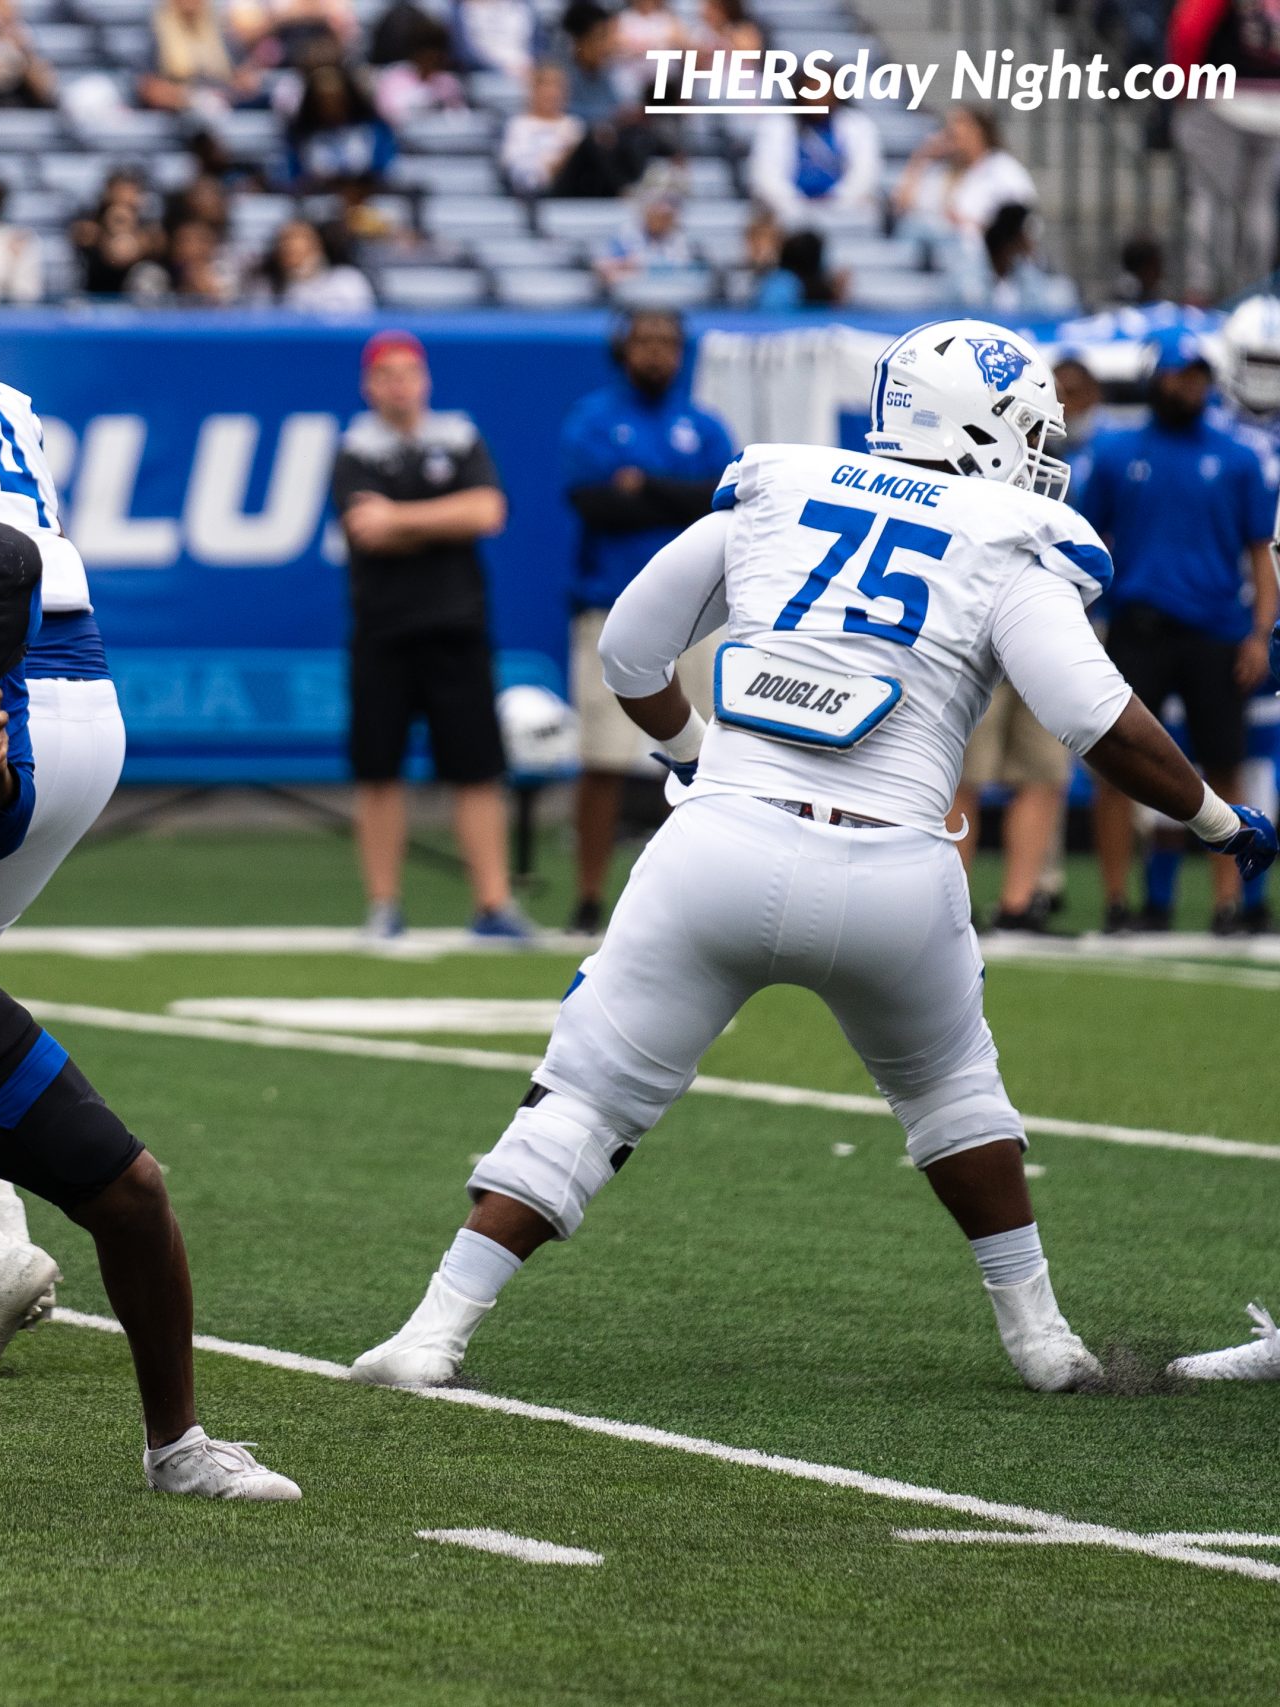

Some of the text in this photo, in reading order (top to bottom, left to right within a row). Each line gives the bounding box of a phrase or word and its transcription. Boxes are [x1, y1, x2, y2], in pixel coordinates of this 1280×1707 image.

[886, 391, 912, 408] SBC
[831, 464, 948, 508] GILMORE
[773, 498, 953, 647] 75
[744, 671, 851, 715] DOUGLAS
